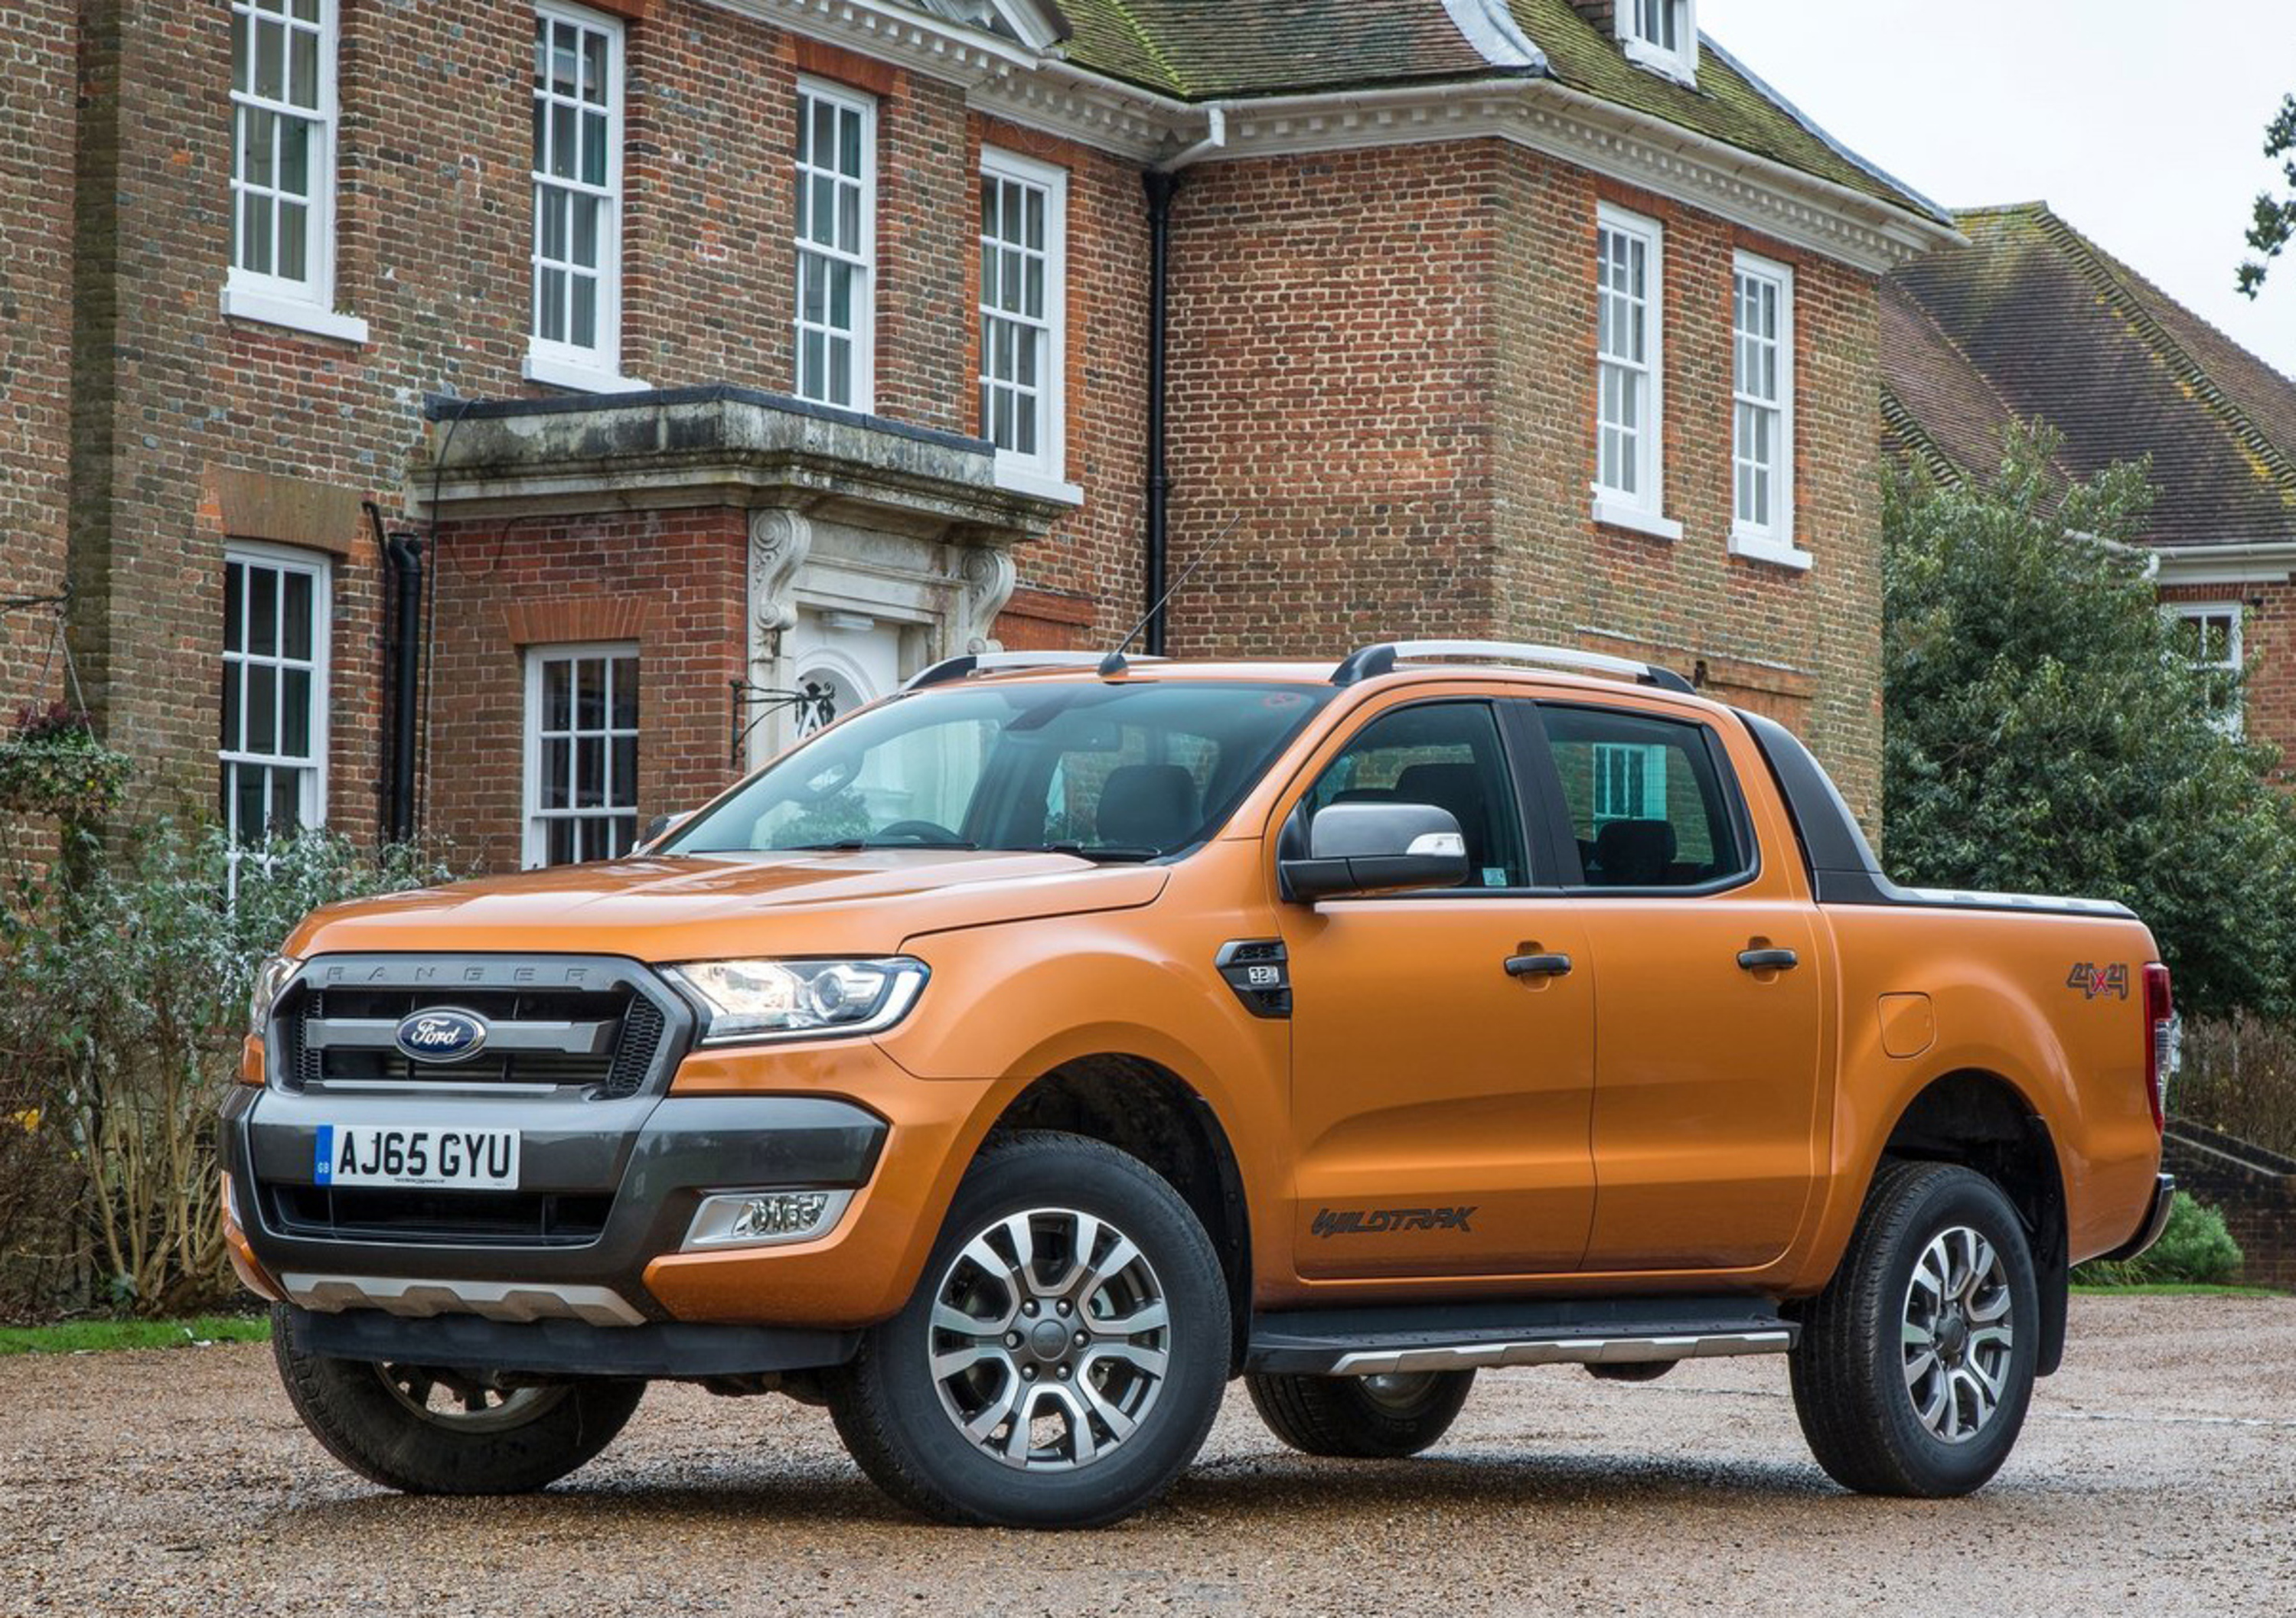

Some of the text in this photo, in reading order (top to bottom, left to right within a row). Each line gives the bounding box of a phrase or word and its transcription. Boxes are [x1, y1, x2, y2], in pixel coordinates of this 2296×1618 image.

[328, 967, 588, 981] RANGER
[411, 1019, 461, 1046] Ford
[317, 1162, 330, 1174] GB
[338, 1131, 511, 1178] AJ65 GYU
[1311, 1206, 1478, 1238] WILDTRAK
